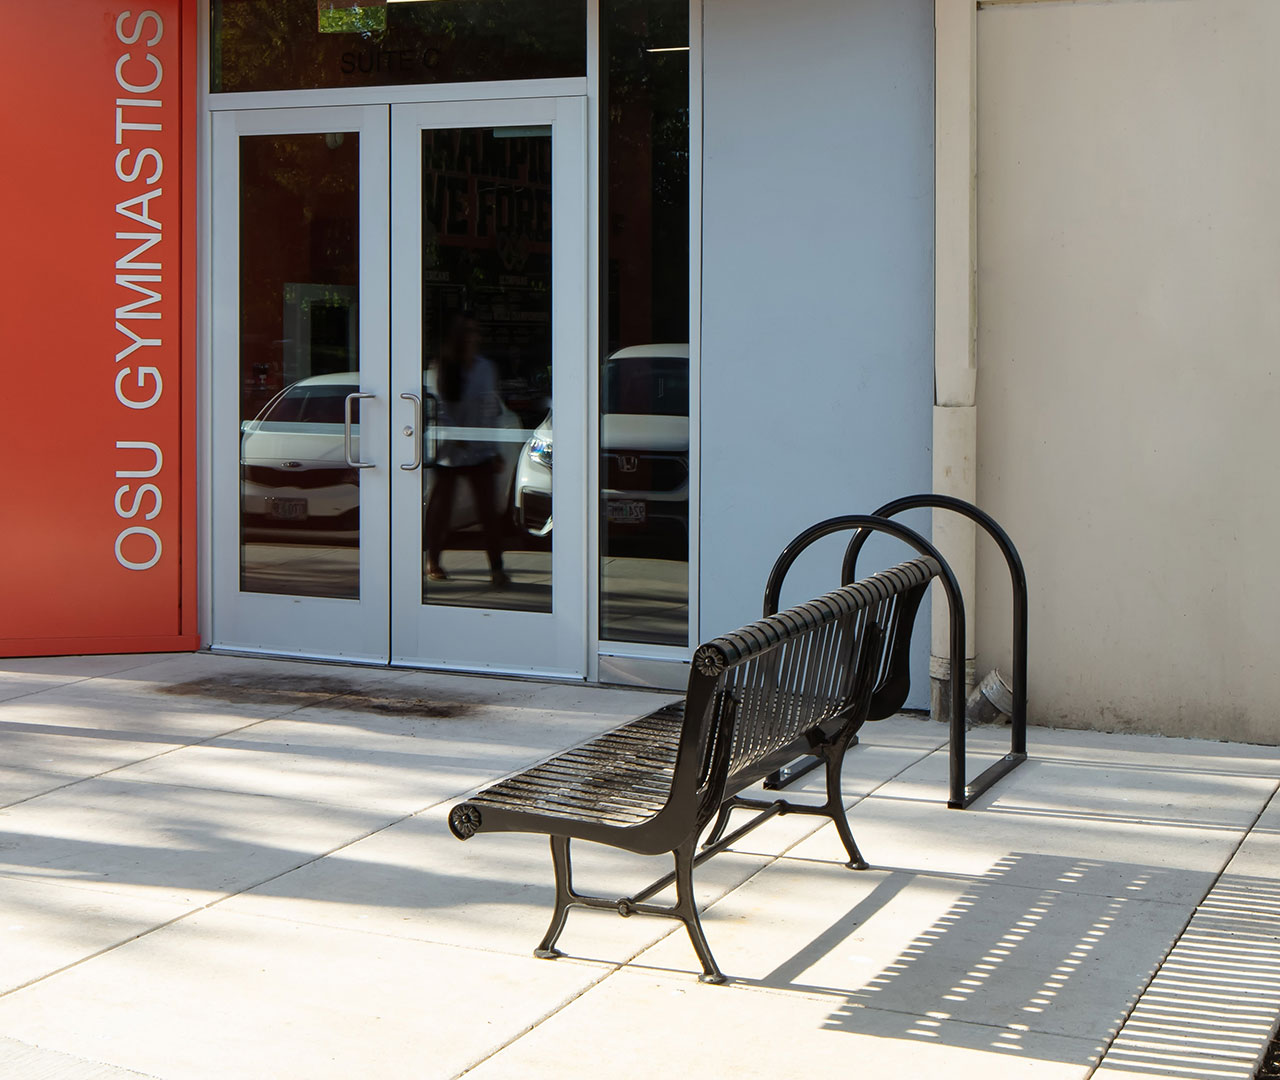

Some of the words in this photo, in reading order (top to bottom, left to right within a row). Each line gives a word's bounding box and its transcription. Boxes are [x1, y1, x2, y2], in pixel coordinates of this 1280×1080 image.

[341, 49, 414, 74] SUITE
[423, 48, 440, 69] C
[115, 9, 164, 410] GYMNASTICS
[115, 441, 163, 571] OSU
